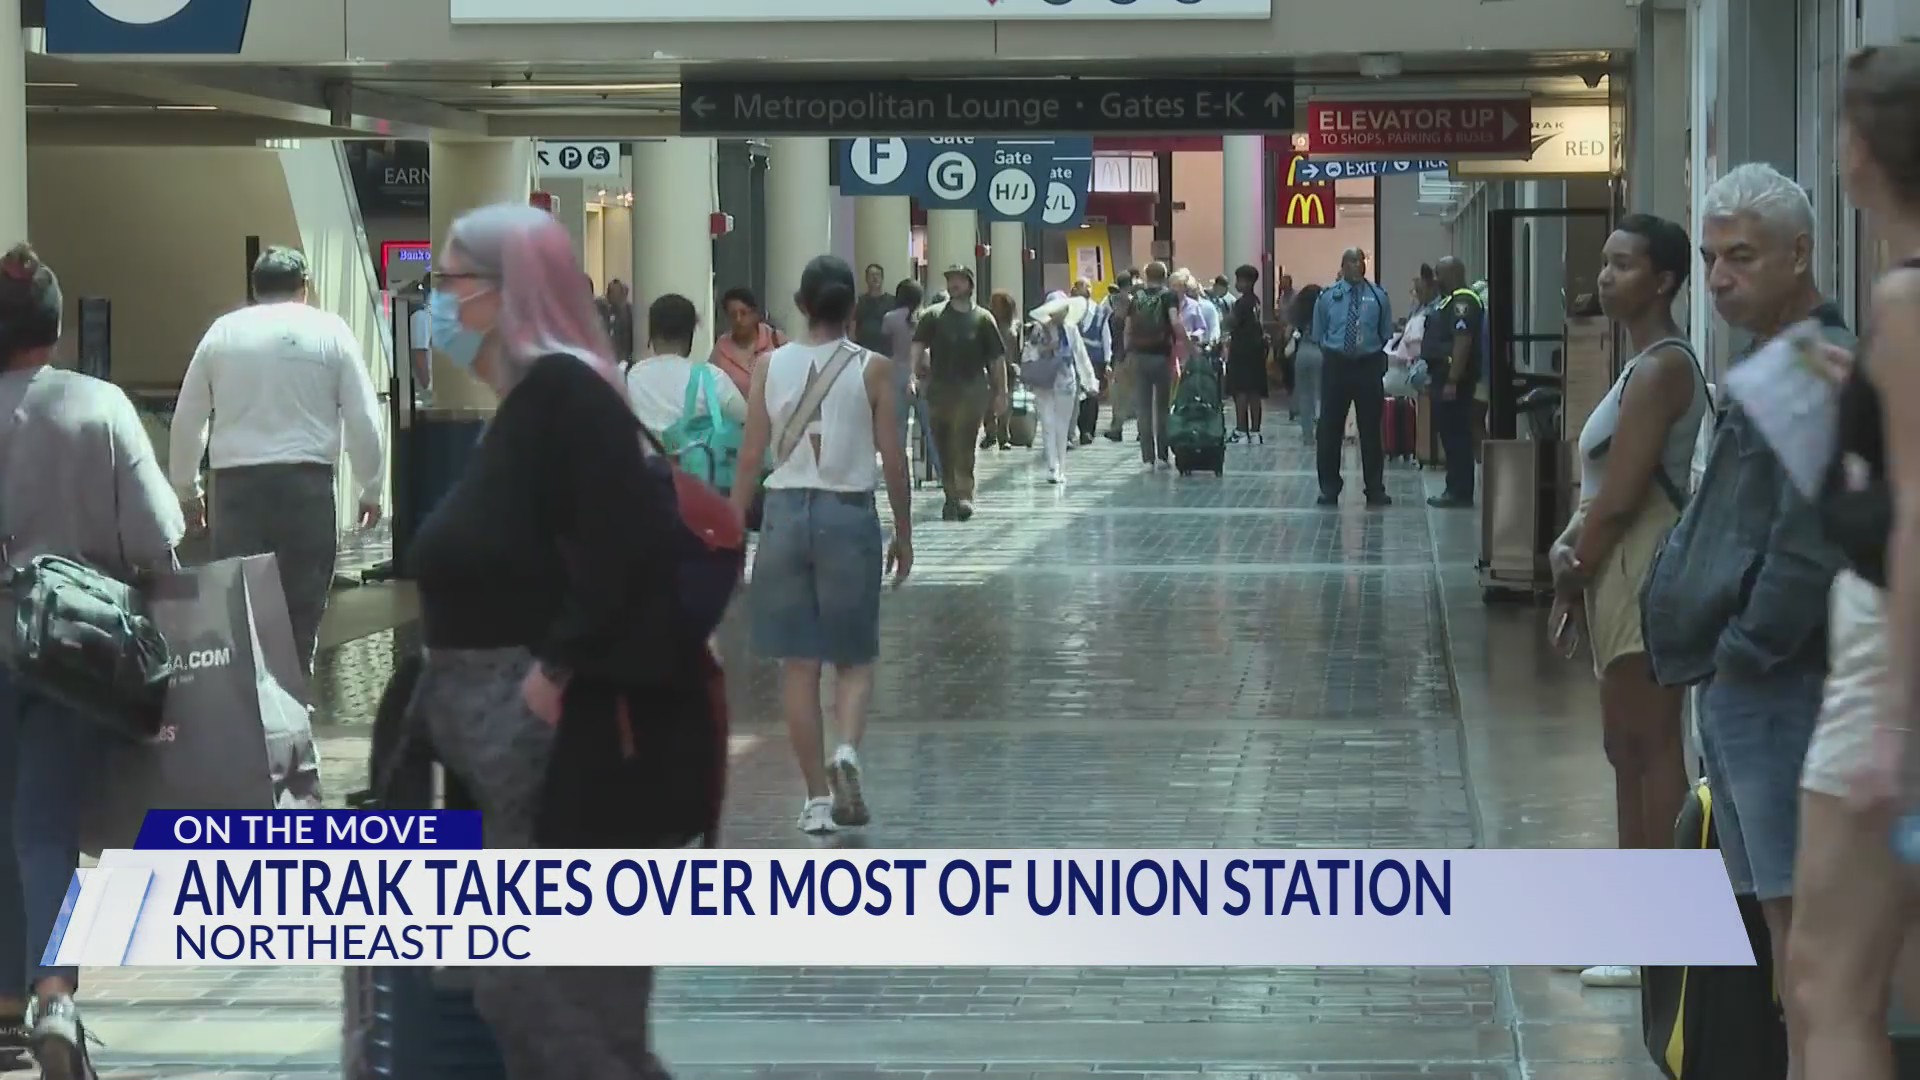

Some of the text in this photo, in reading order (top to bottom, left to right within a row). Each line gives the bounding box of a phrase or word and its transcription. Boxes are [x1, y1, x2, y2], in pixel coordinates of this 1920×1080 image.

[733, 92, 1245, 125] Metropolitan Lounge Gates E-K
[1319, 108, 1495, 131] ELEVATOR UP
[1321, 133, 1338, 145] TO
[1340, 132, 1385, 146] SHOPS,
[1387, 132, 1441, 144] PARKING
[869, 138, 891, 176] F
[994, 149, 1034, 165] Gate
[1564, 140, 1605, 157] RED
[384, 167, 431, 184] EARN
[936, 159, 965, 192] G
[1049, 166, 1073, 180] ate
[1346, 161, 1377, 176] Exit
[995, 182, 1030, 201] H/J
